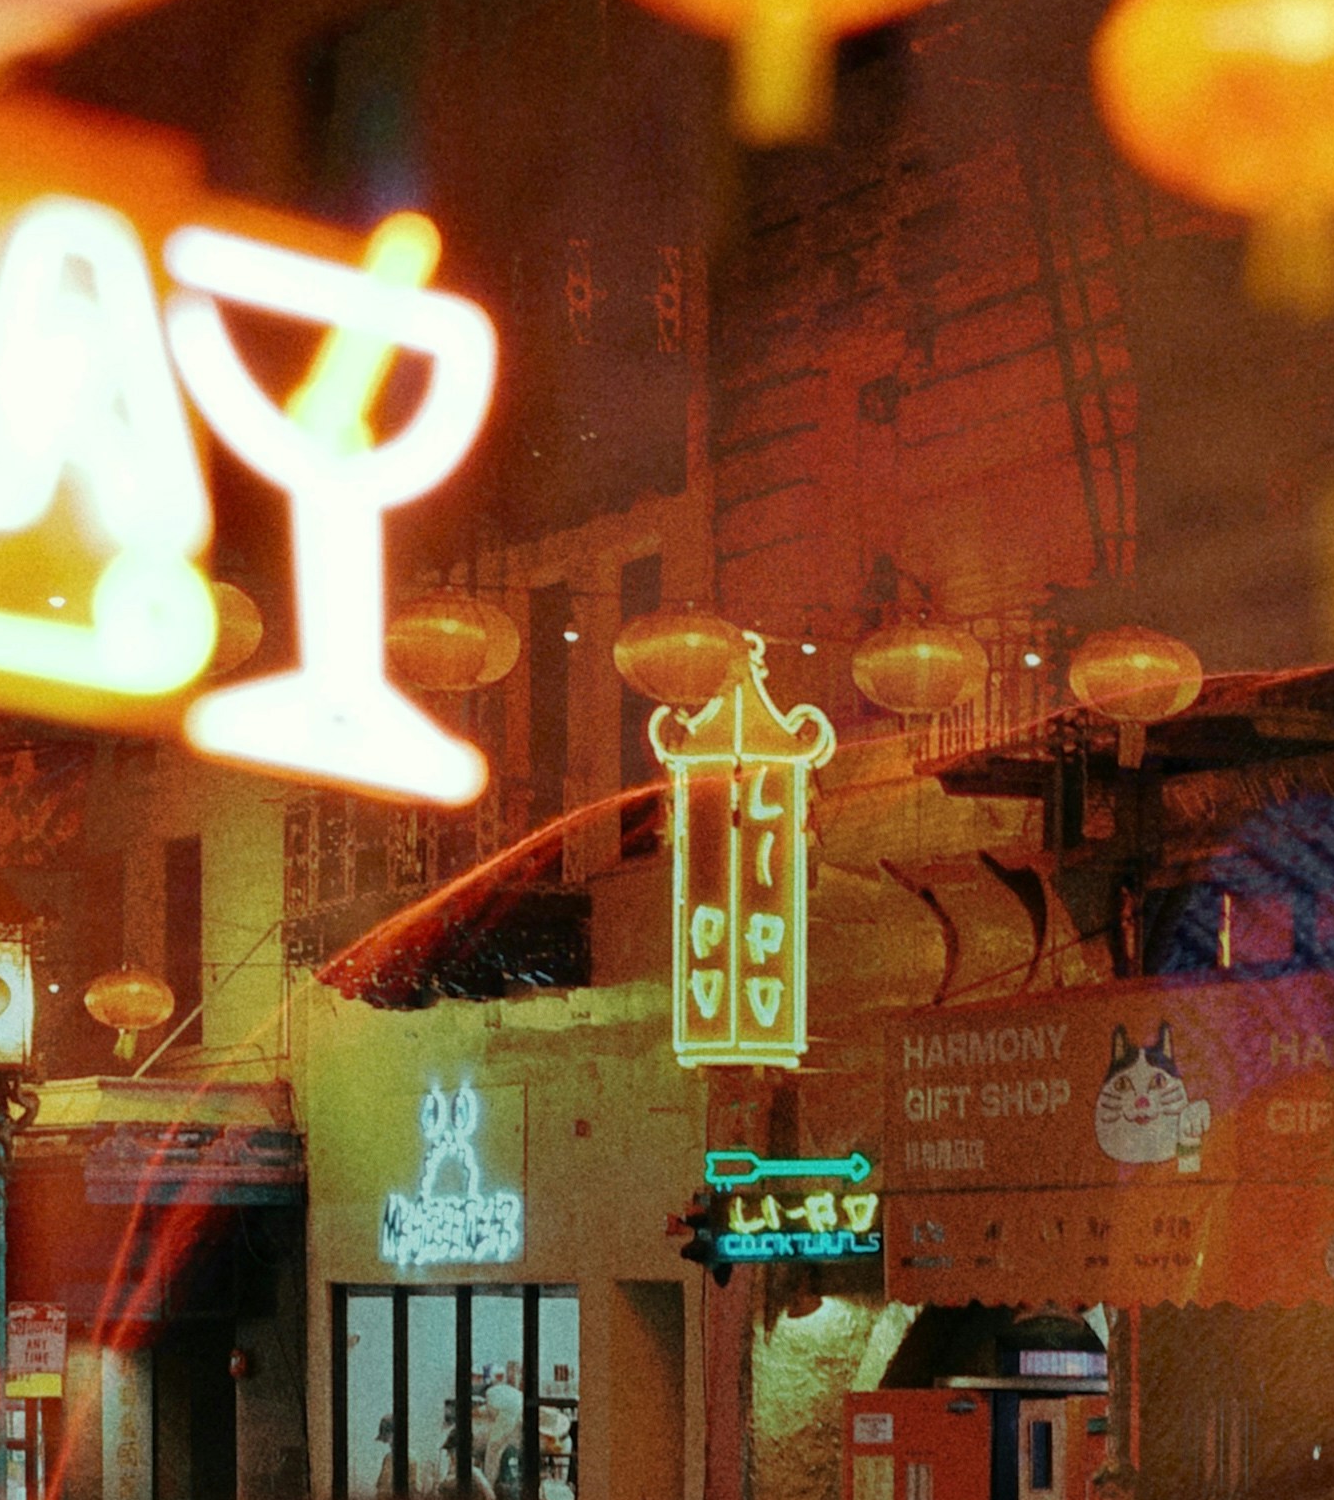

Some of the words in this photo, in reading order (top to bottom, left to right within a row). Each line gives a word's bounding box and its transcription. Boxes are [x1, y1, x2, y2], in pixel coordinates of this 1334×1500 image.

[902, 1023, 1068, 1070] HARMONY
[903, 1084, 972, 1122] GIFT
[980, 1078, 1072, 1118] SHOP
[723, 1231, 881, 1257] COCKTAILS
[24, 1352, 50, 1365] TIME
